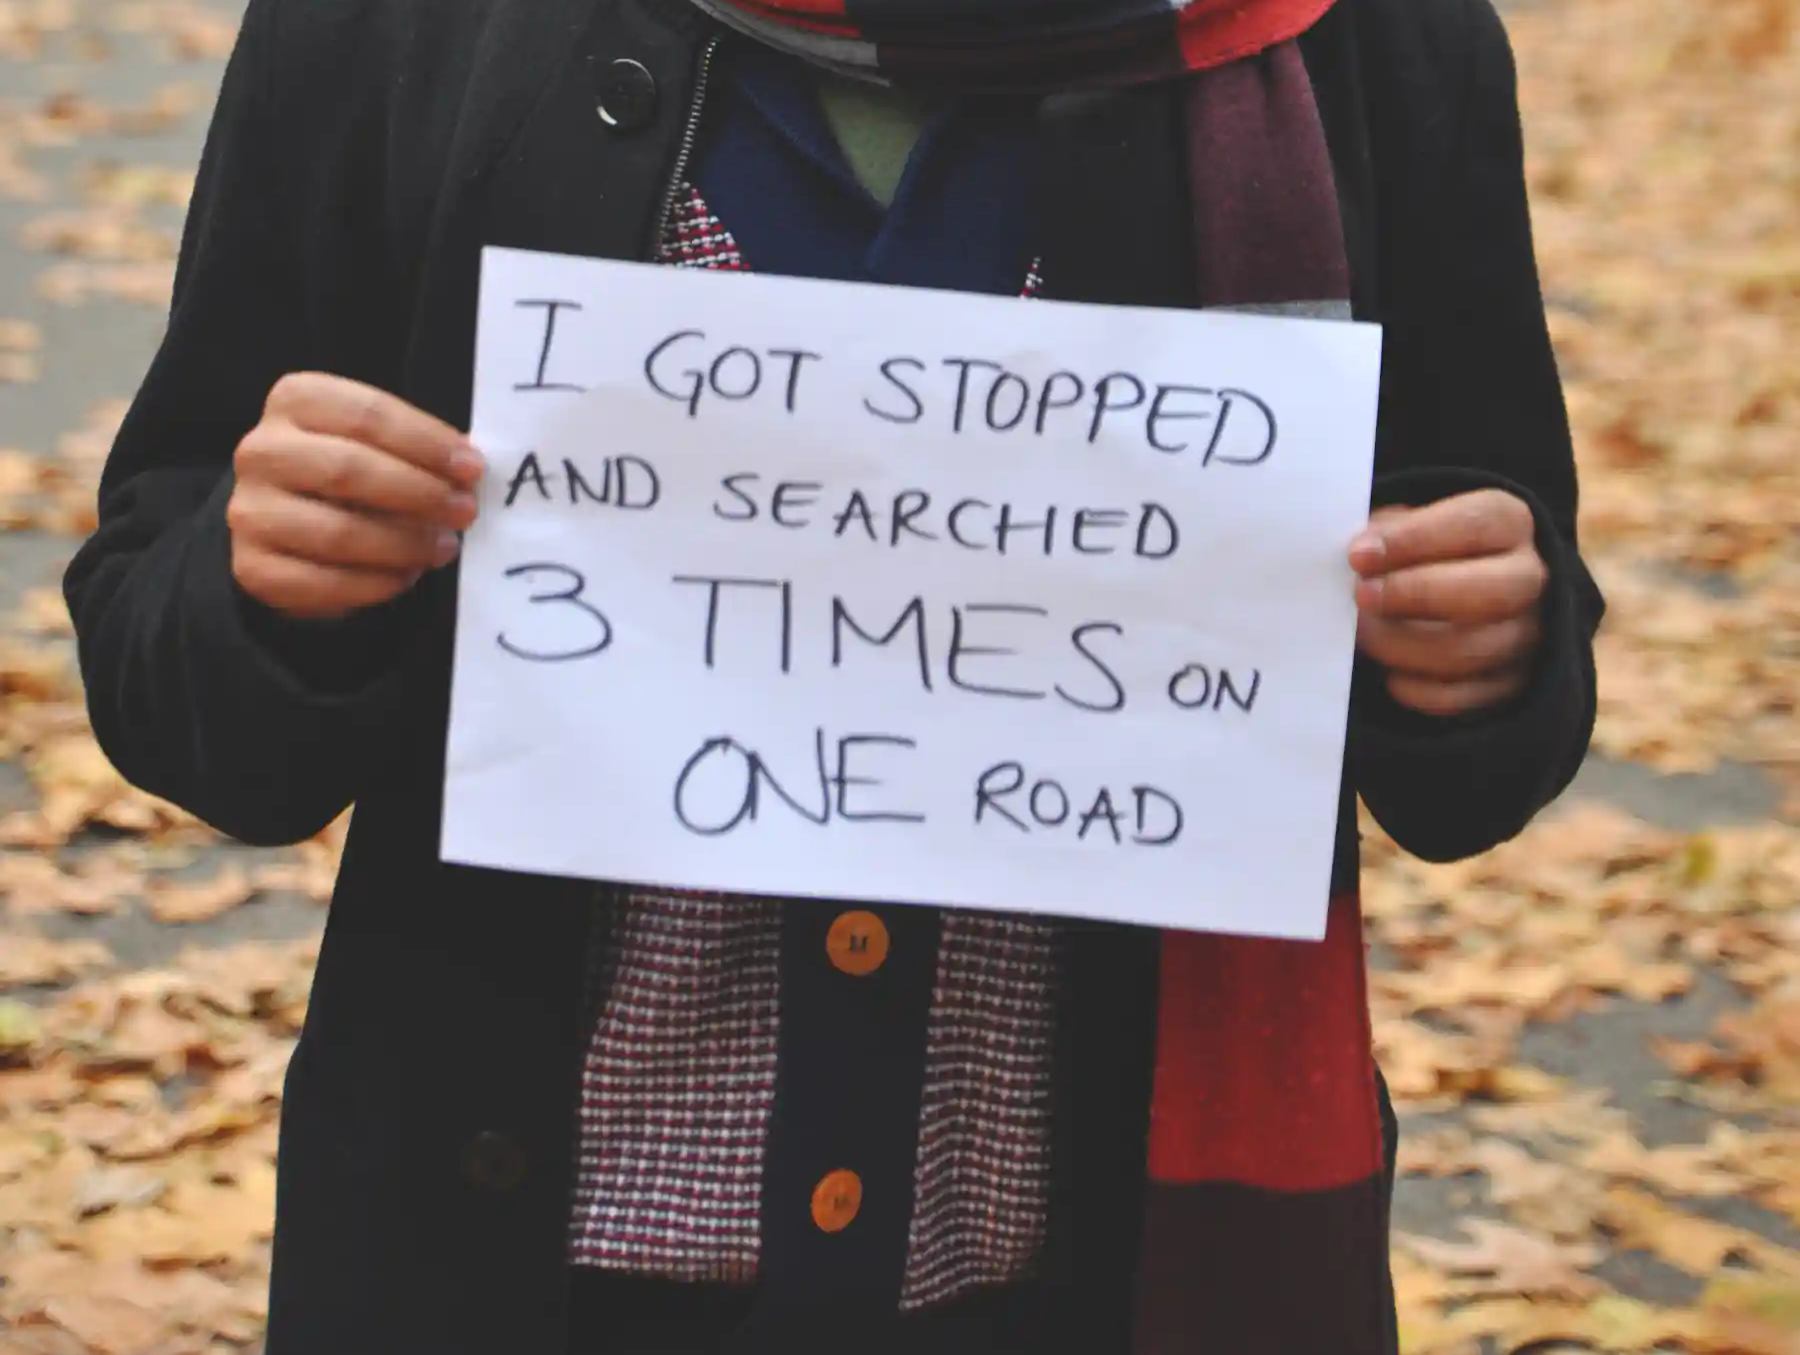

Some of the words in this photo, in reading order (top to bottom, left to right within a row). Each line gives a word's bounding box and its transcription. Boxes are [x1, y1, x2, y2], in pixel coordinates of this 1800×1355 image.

[513, 300, 585, 392] I
[644, 331, 822, 417] GOT
[864, 357, 1277, 468] STOPPED
[504, 451, 660, 509] AND
[713, 472, 1180, 560] SEARCHED
[497, 563, 613, 661] 3
[672, 575, 1126, 713] TIMES
[1168, 662, 1261, 713] ON
[674, 727, 926, 836] ONE
[974, 761, 1184, 845] ROAD
